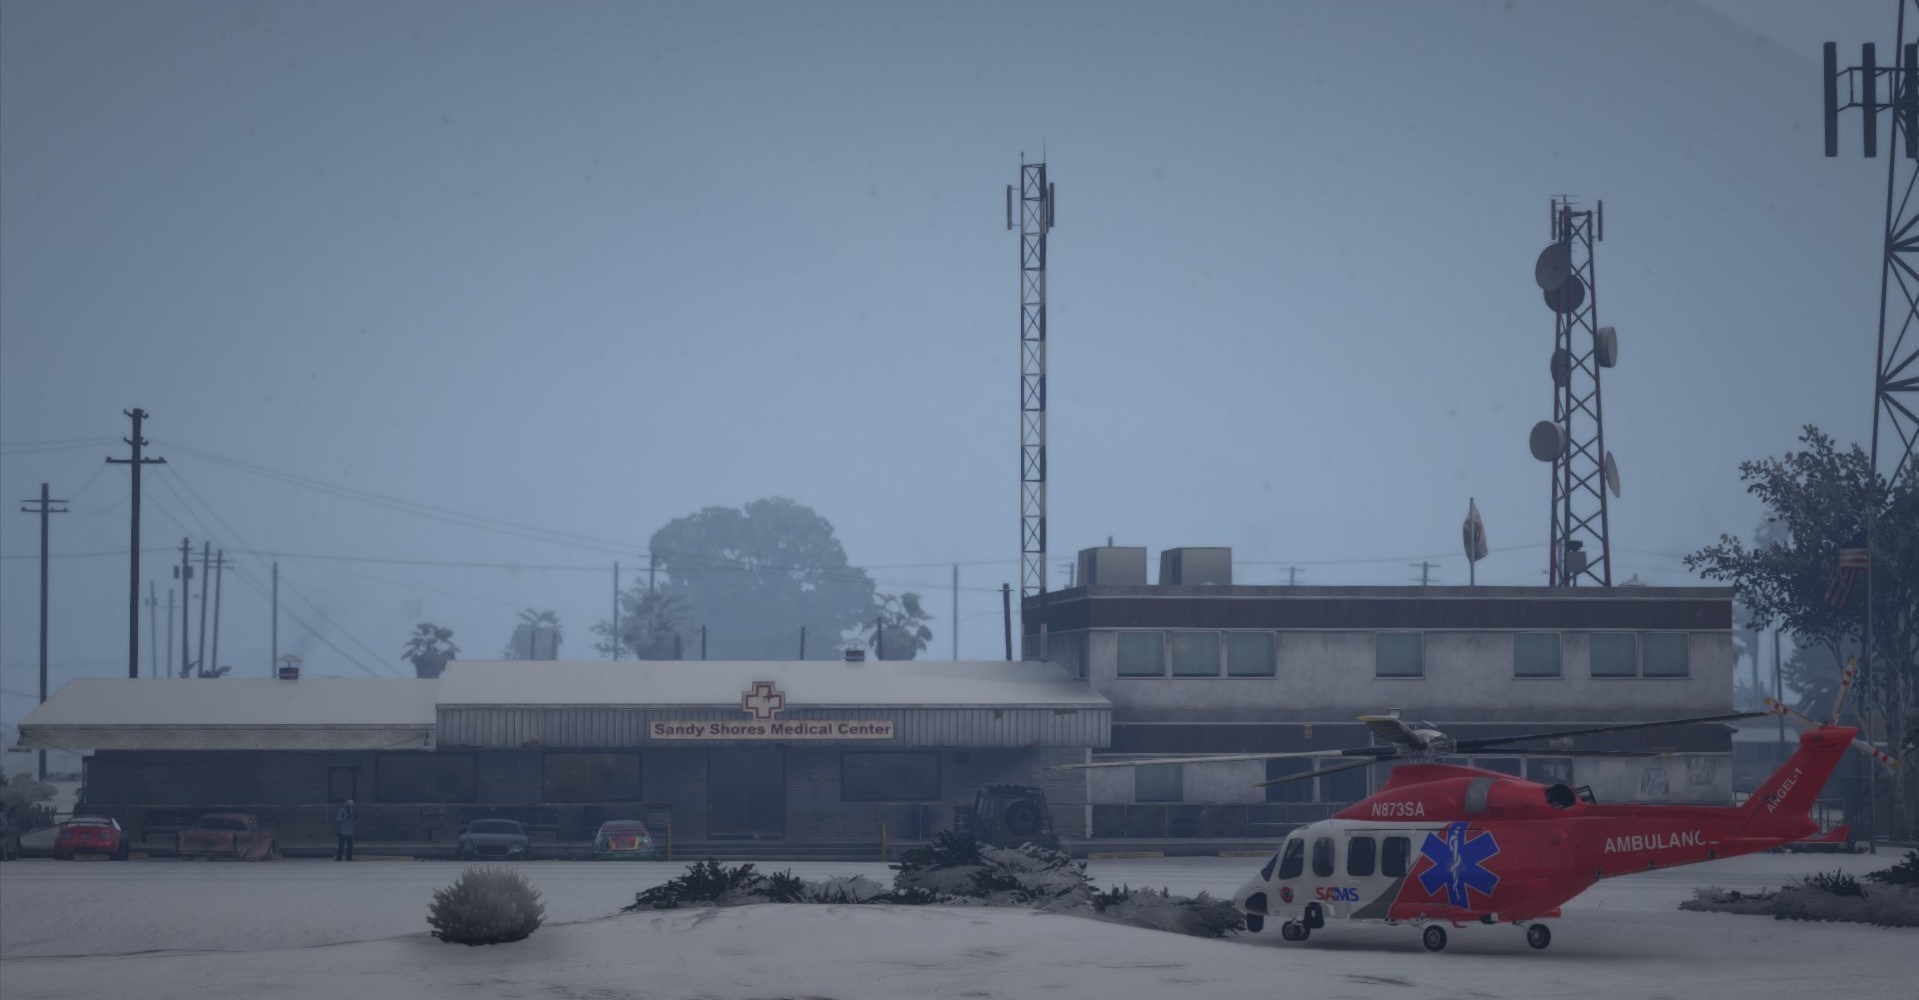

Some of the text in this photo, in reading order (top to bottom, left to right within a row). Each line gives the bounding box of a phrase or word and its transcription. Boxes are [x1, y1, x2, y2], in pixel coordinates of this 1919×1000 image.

[654, 723, 891, 738] Sandy Shores Medical Center
[1766, 767, 1804, 814] ANGEL-1
[1371, 801, 1425, 817] N873SA
[1604, 829, 1720, 854] AMBULANC
[1315, 886, 1360, 902] SAMS
